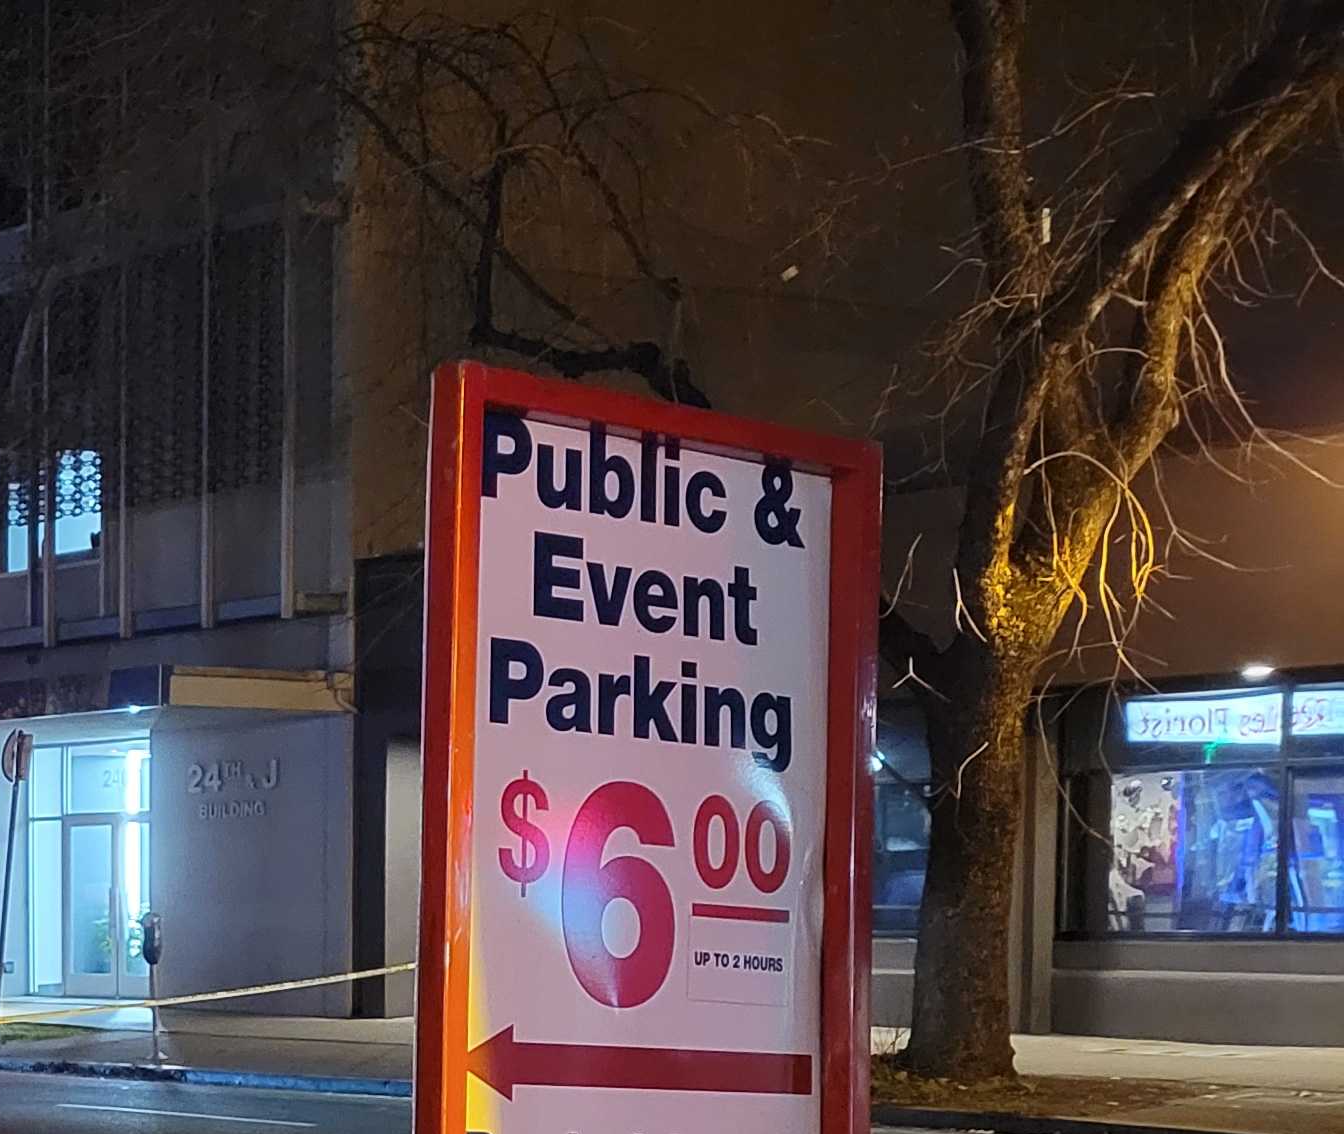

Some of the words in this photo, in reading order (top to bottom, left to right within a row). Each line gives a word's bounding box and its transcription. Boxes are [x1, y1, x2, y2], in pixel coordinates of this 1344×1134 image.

[481, 410, 727, 533] Public
[754, 455, 806, 549] &
[533, 530, 758, 646] Event
[489, 637, 792, 773] Parking
[199, 801, 266, 819] BUILDING
[262, 758, 279, 789] J
[694, 951, 710, 966] UP
[713, 952, 730, 967] TO
[732, 954, 741, 969] 2
[743, 955, 783, 972] HOURS
